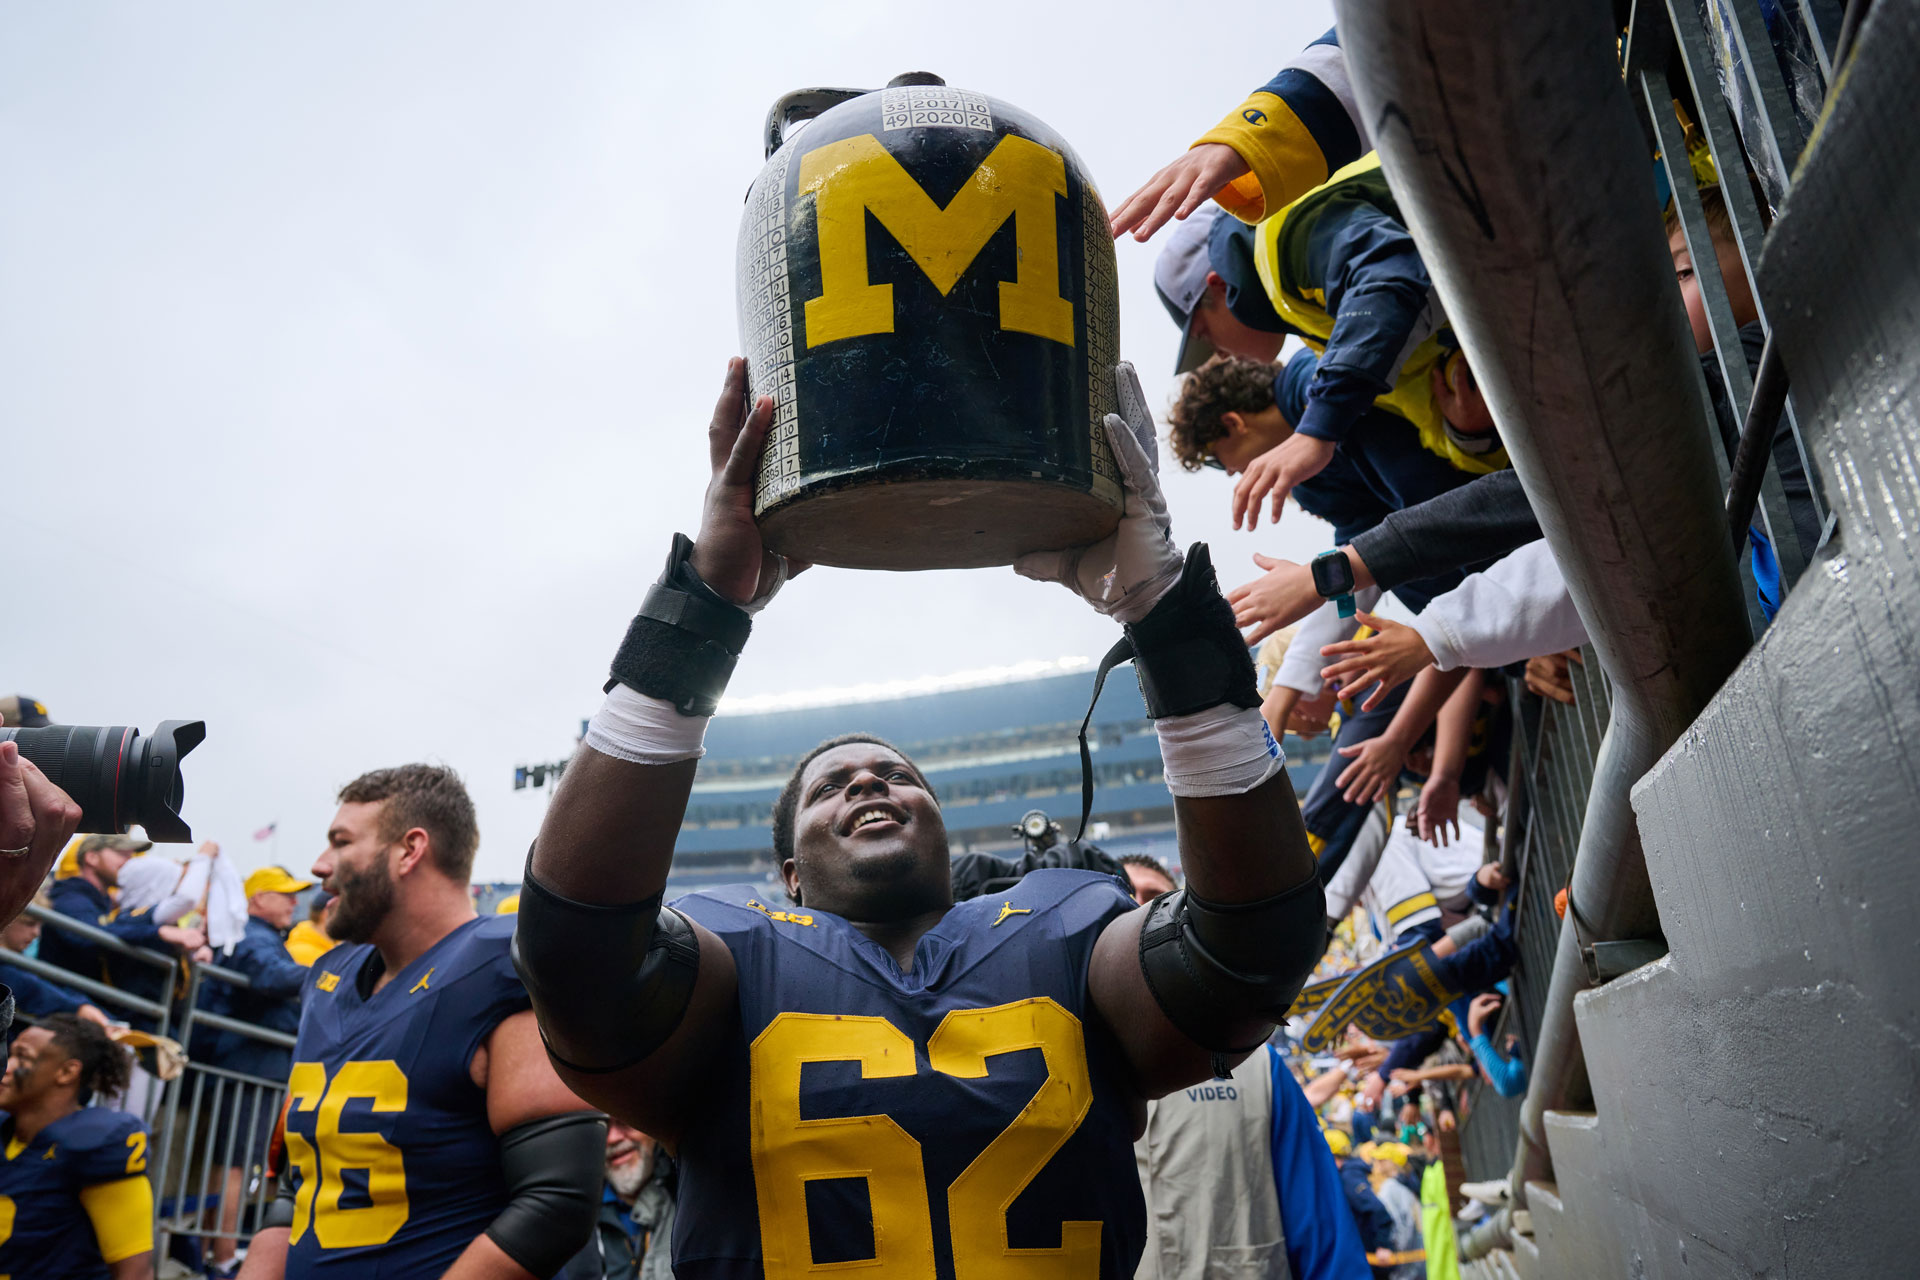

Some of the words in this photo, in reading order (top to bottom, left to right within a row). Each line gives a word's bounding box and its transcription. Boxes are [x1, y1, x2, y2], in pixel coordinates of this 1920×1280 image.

[885, 101, 907, 113] 33
[914, 99, 960, 109] 2017
[968, 102, 987, 113] 10
[886, 113, 908, 128] 49
[915, 111, 964, 124] 2020
[969, 115, 991, 129] 24
[769, 198, 781, 213] 13
[771, 214, 780, 226] 7
[771, 230, 782, 245] 0
[799, 133, 1080, 349] M
[772, 249, 782, 261] 7
[773, 263, 782, 277] 0
[773, 280, 785, 297] 21
[776, 299, 786, 312] 0
[775, 316, 787, 331] 16
[777, 332, 789, 347] 10
[778, 351, 788, 364] 21
[780, 367, 791, 383] 14
[781, 387, 791, 402] 13
[783, 405, 793, 419] 14
[784, 424, 794, 437] 10
[785, 442, 793, 455] 7
[786, 459, 794, 472] 7
[1186, 1086, 1237, 1103] VIDEO
[750, 996, 1104, 1280] 62
[125, 1131, 148, 1174] 2
[284, 1060, 409, 1248] 66
